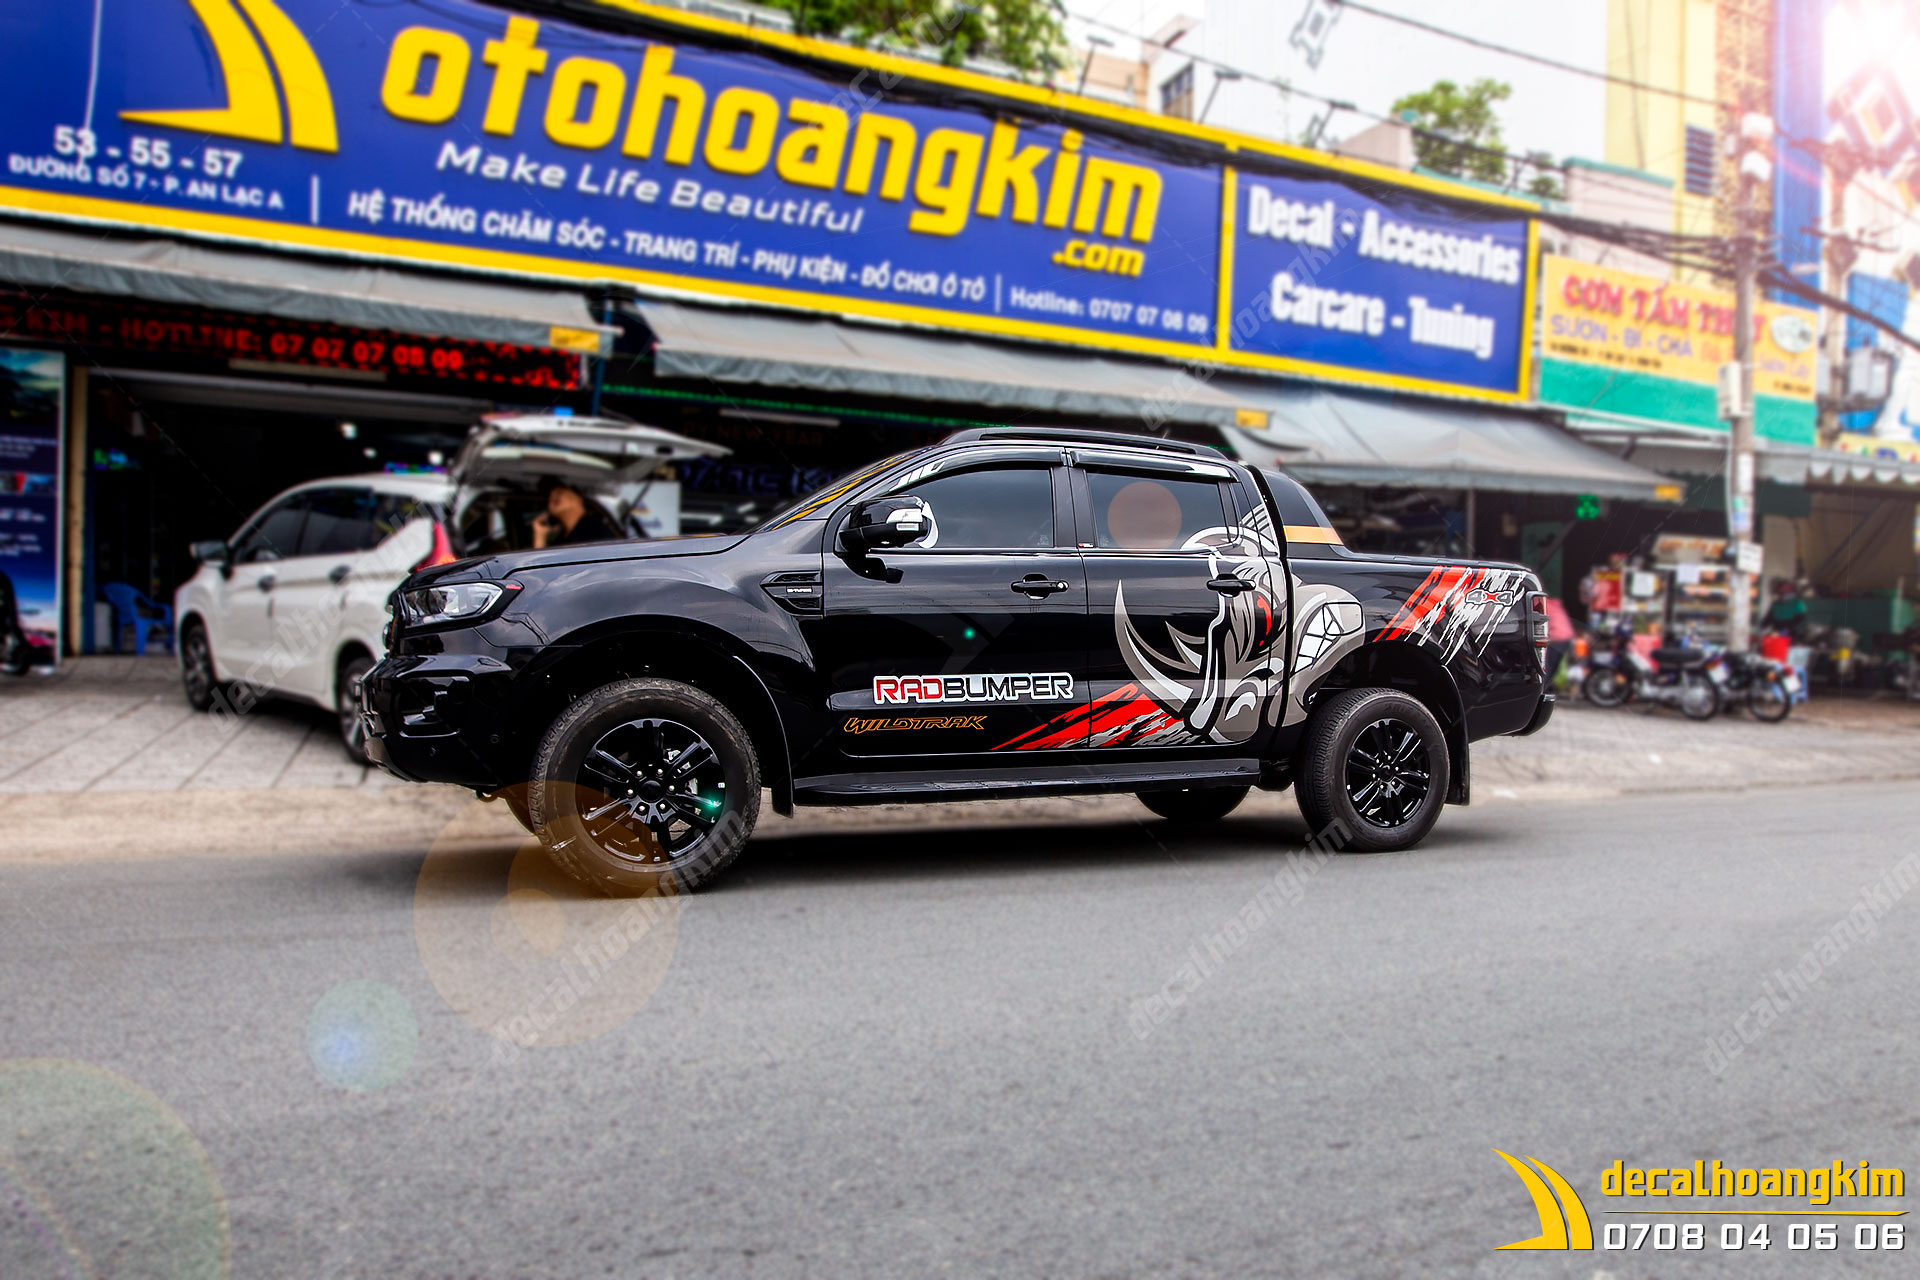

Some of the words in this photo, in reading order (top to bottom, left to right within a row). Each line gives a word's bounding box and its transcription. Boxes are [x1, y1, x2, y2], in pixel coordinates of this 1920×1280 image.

[54, 125, 97, 158] 53
[130, 136, 171, 168] 55
[203, 147, 242, 177] 57
[382, 15, 1162, 243] otohoangkim
[132, 172, 146, 190] 7
[267, 192, 284, 209] A
[436, 141, 566, 188] Make
[577, 163, 660, 203] Life
[669, 179, 864, 233] Beautiful
[347, 186, 385, 225] HỆ
[391, 193, 477, 232] THỐNG
[556, 216, 606, 250] SÓC
[623, 231, 698, 262] TRANG
[703, 241, 740, 268] TRÍ
[752, 250, 796, 280] PHỤ
[800, 255, 847, 284] KIỆN
[1052, 240, 1145, 277] .com
[1247, 184, 1335, 249] Decal
[1358, 209, 1521, 286] Accessories
[1010, 286, 1084, 316] Hotline:
[1089, 298, 1133, 323] 0707
[1136, 305, 1159, 327] 07
[1162, 310, 1184, 332] 08
[1270, 271, 1386, 337] Carcare
[1407, 296, 1495, 360] Tuning
[120, 318, 261, 352] HOTLINE:
[270, 332, 303, 356] 07
[312, 336, 344, 360] 07
[353, 341, 385, 363] 07
[873, 672, 1074, 704] RADBUMPER
[843, 715, 989, 734] WILDTRAK
